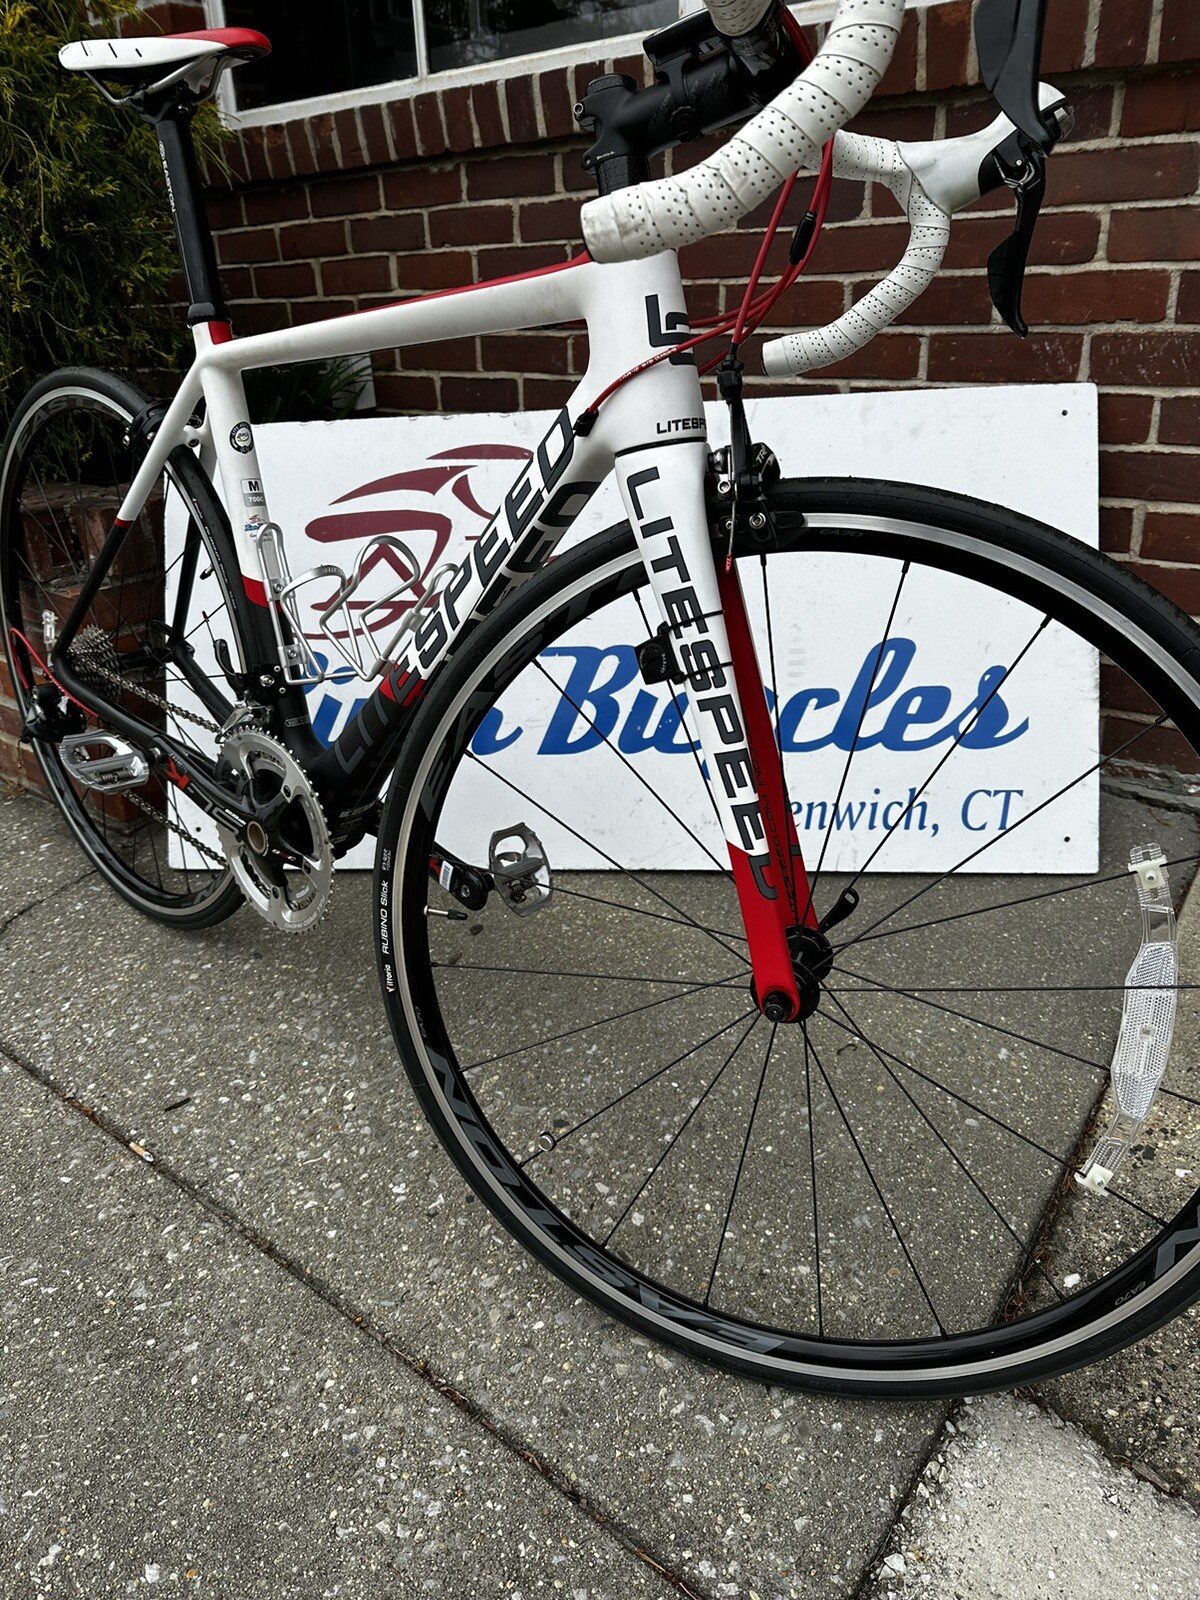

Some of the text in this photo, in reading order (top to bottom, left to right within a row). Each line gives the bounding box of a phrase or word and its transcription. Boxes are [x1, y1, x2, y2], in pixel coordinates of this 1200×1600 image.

[656, 417, 707, 435] LITESP
[248, 480, 260, 492] M
[626, 467, 779, 900] LITESPEED
[960, 788, 1024, 832] CT
[379, 880, 389, 907] Slick
[379, 908, 390, 955] RUBINO
[425, 1044, 786, 1355] EASTON
[1114, 1280, 1147, 1306] EA70
